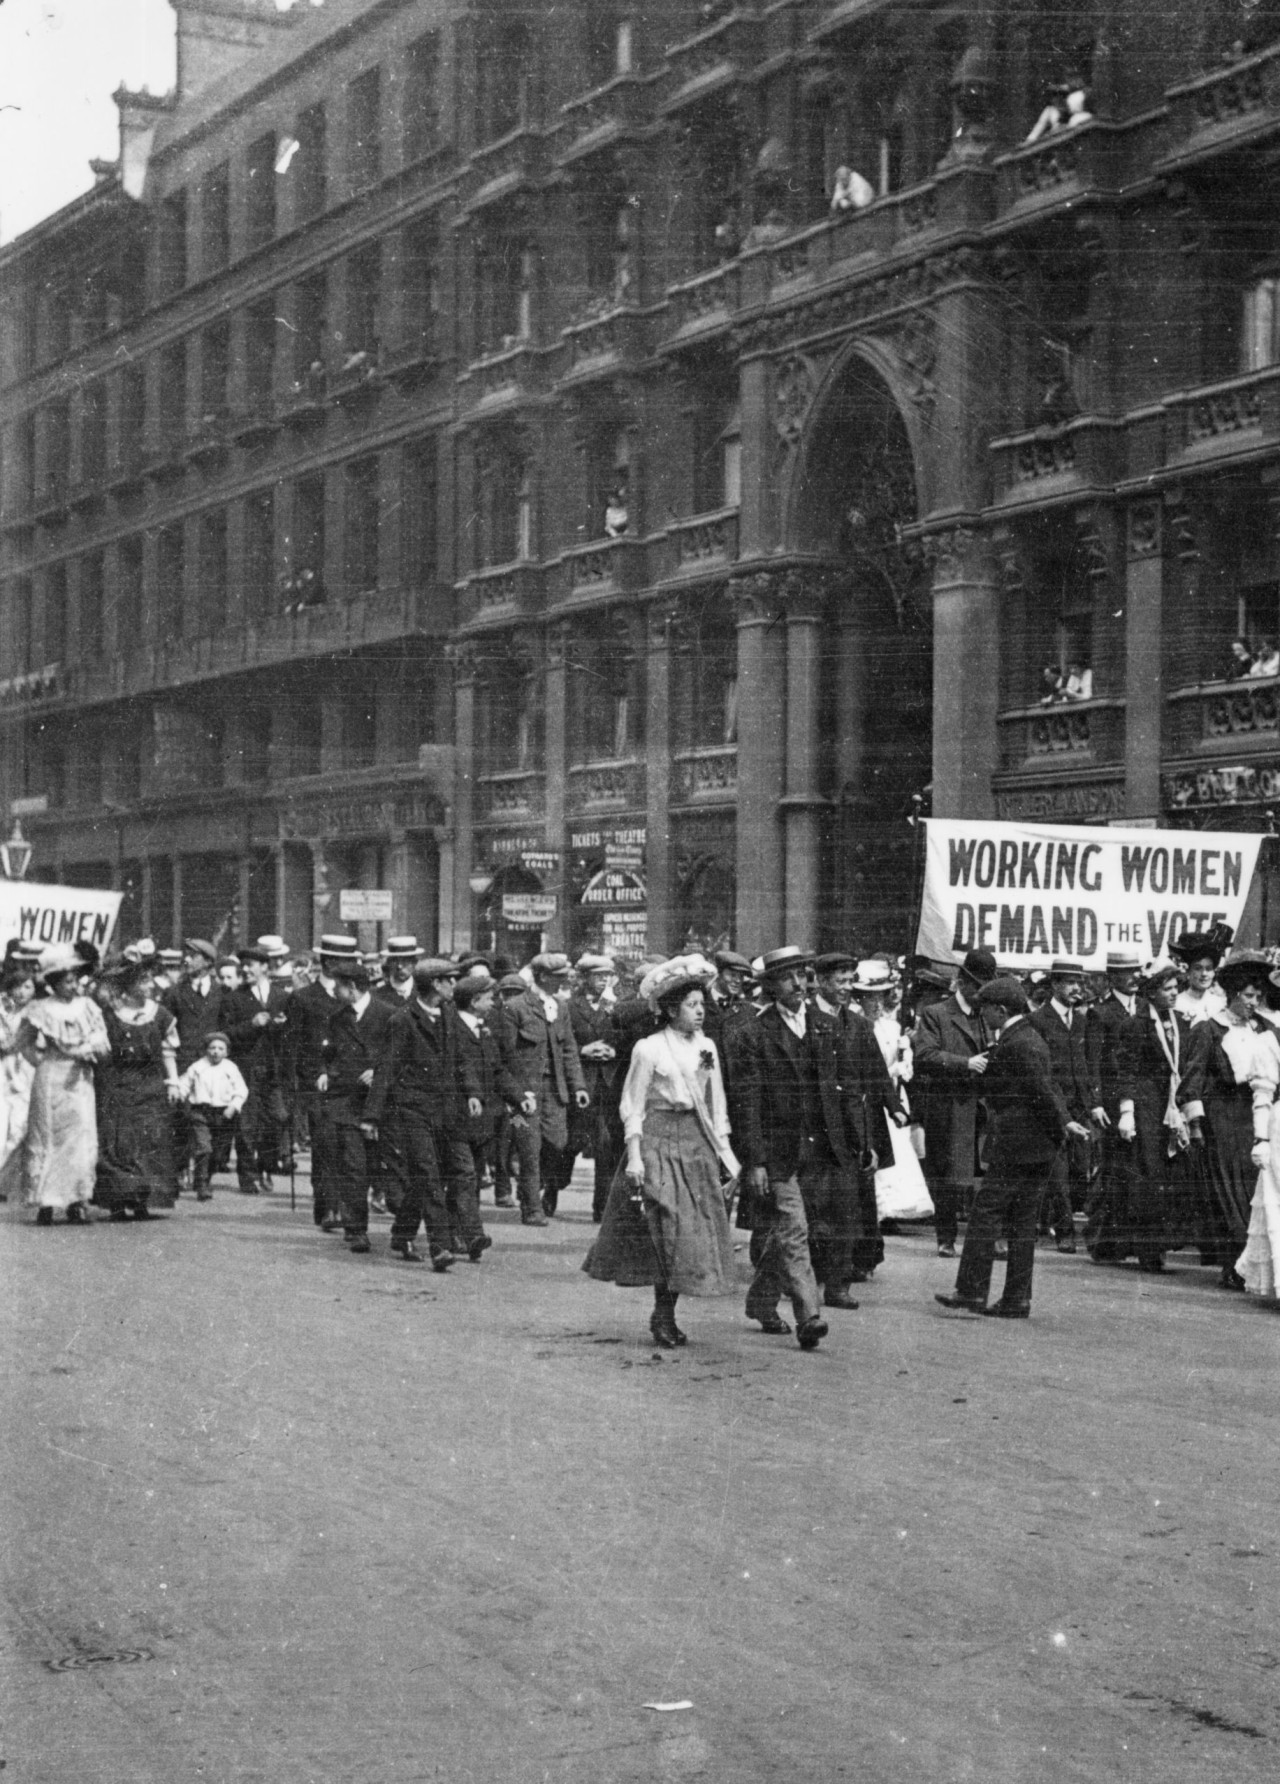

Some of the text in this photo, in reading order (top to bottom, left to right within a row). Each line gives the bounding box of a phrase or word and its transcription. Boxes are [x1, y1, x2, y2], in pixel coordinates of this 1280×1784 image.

[948, 838, 1242, 897] WORKING WOMEN
[20, 906, 109, 945] WOMEN
[952, 903, 1098, 956] DEMAND
[1104, 922, 1143, 943] THE
